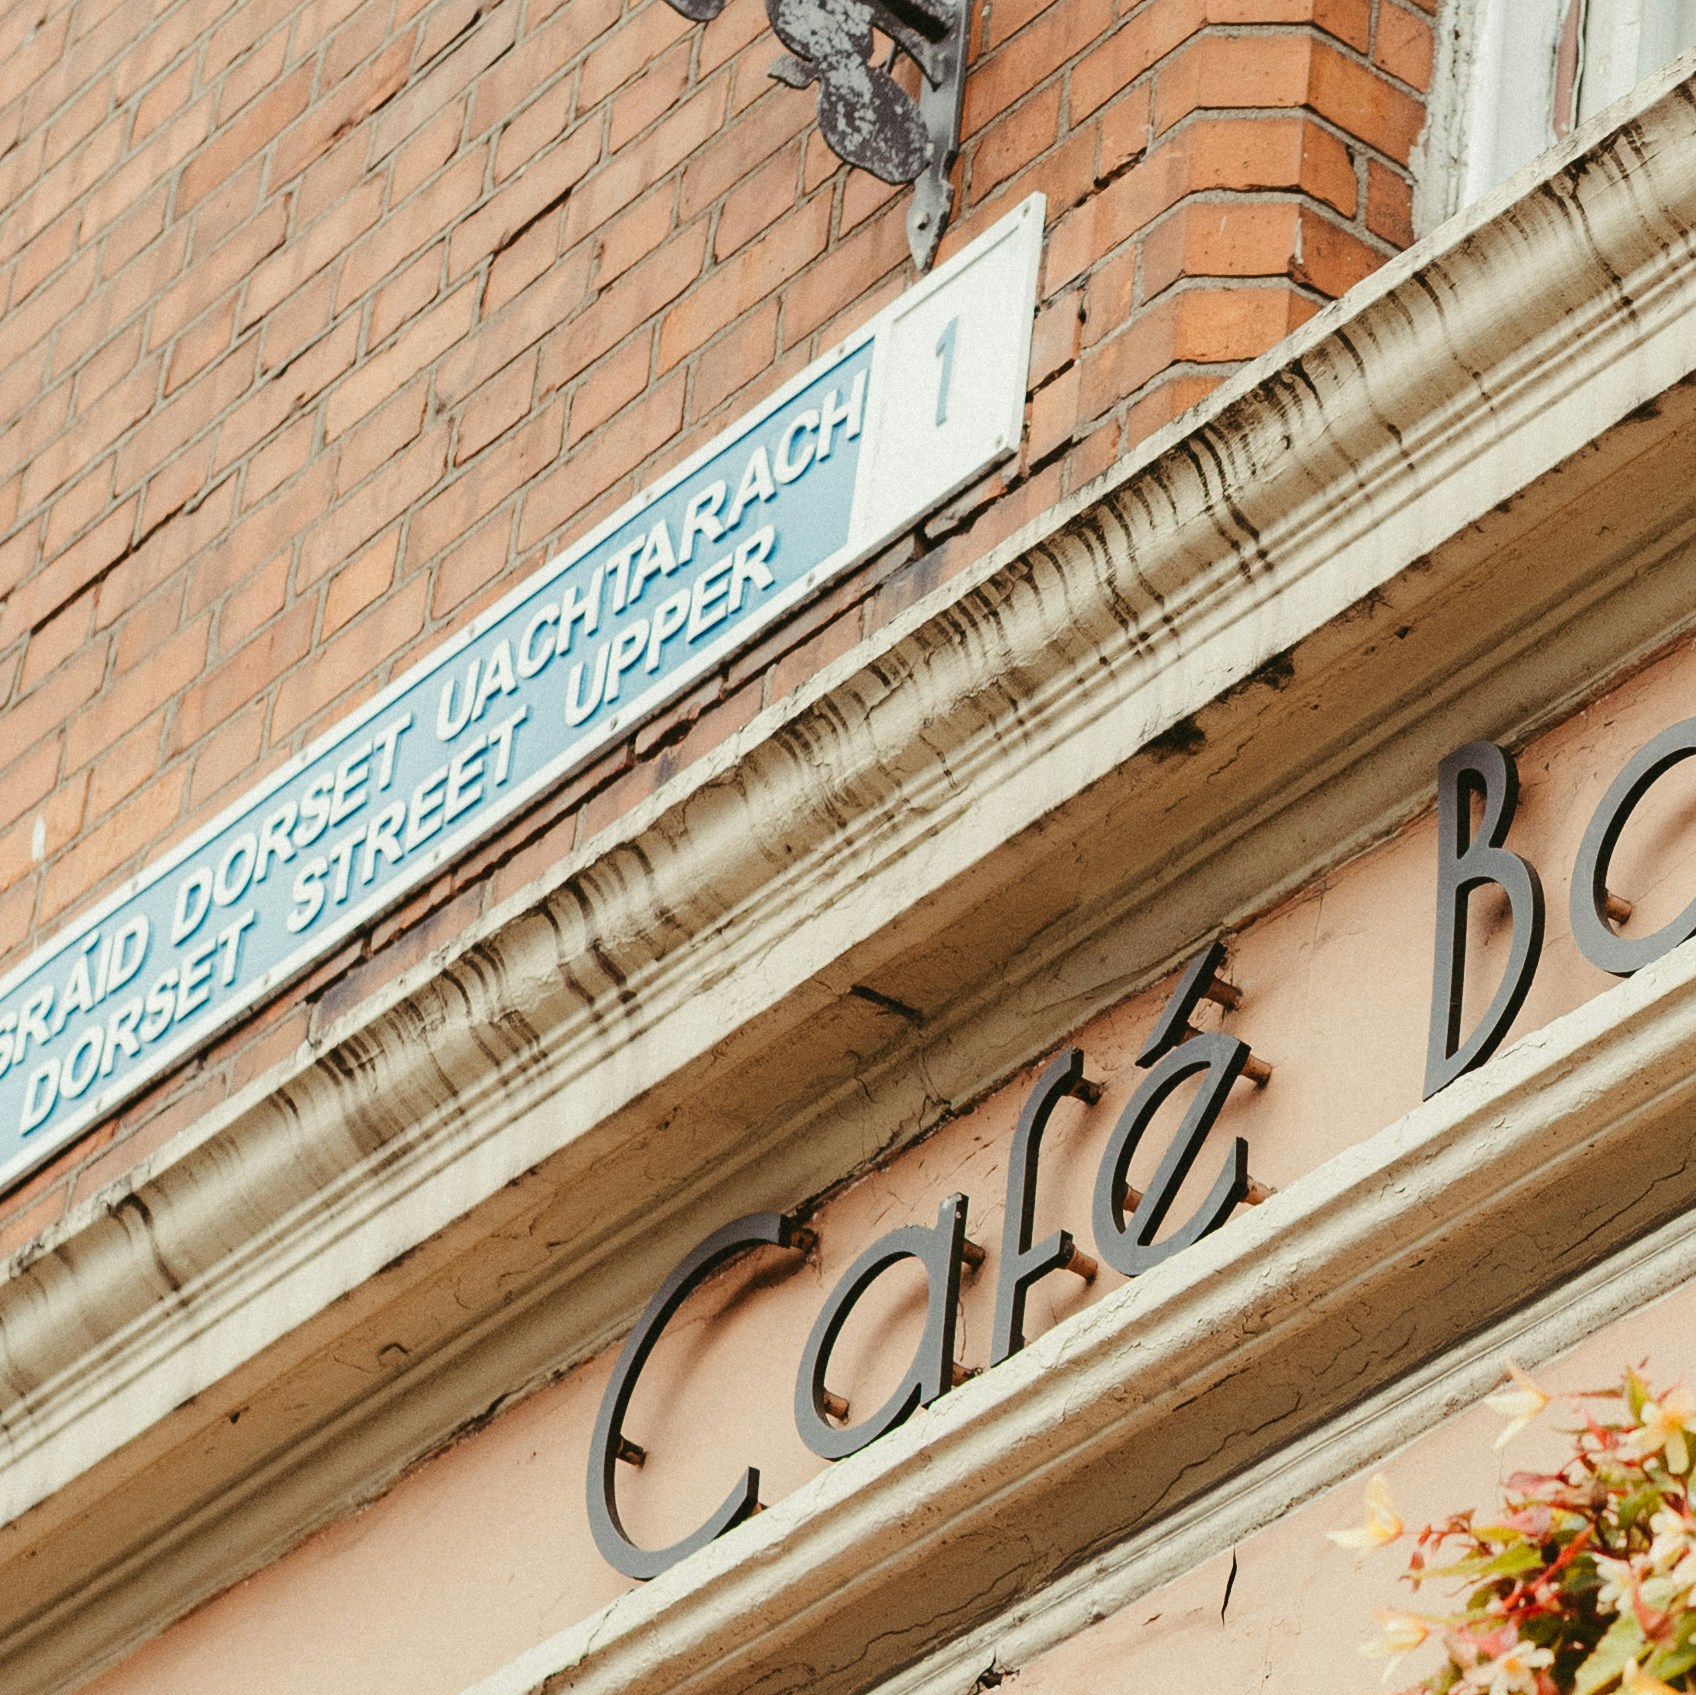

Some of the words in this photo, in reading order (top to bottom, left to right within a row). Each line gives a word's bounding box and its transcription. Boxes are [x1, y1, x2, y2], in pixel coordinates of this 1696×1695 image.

[171, 712, 413, 946] DORSET
[436, 369, 868, 742] UACHTARACH
[932, 314, 960, 426] 1
[18, 909, 258, 1137] DORSET
[286, 704, 529, 934] STREET
[563, 523, 777, 729] UPPER
[584, 938, 1253, 1583] Café
